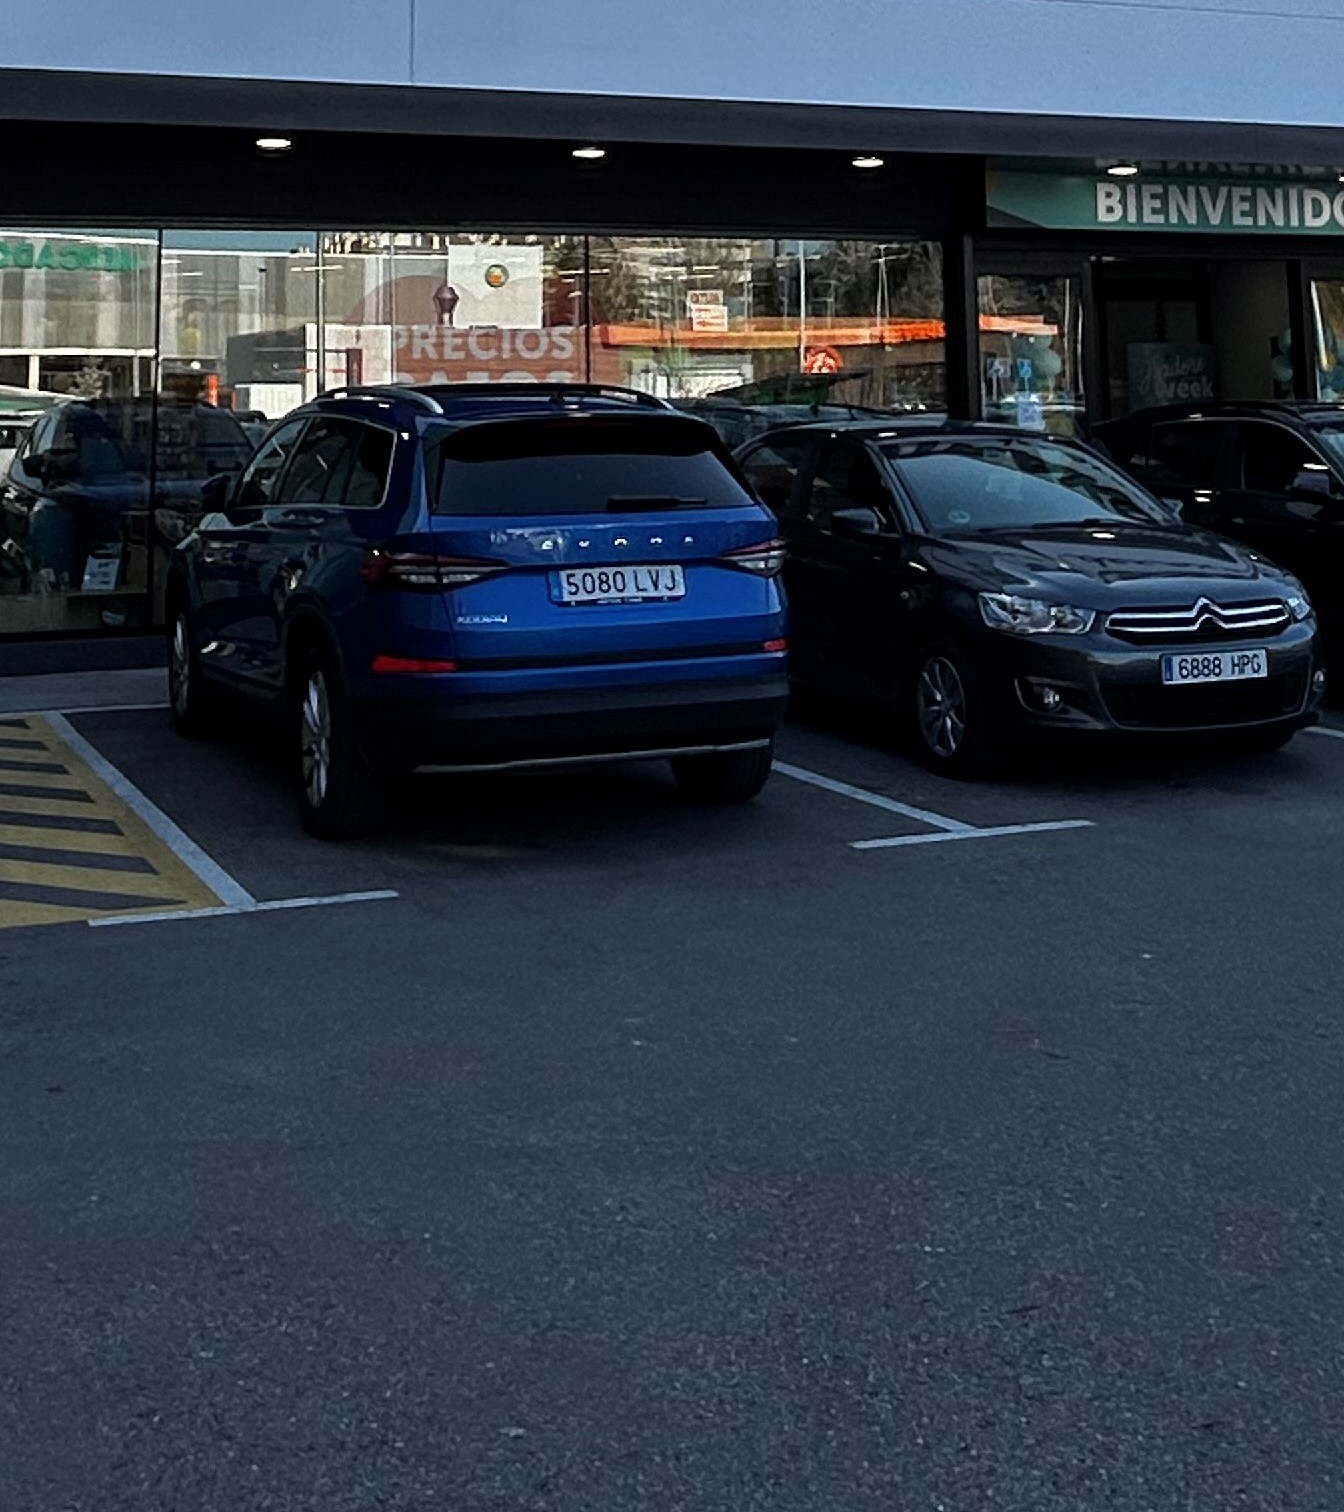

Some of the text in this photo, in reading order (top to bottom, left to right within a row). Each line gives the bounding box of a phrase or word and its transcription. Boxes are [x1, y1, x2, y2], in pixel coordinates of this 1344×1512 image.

[566, 569, 677, 596] 5080 LVJ
[1179, 653, 1261, 679] 6888 HPG
